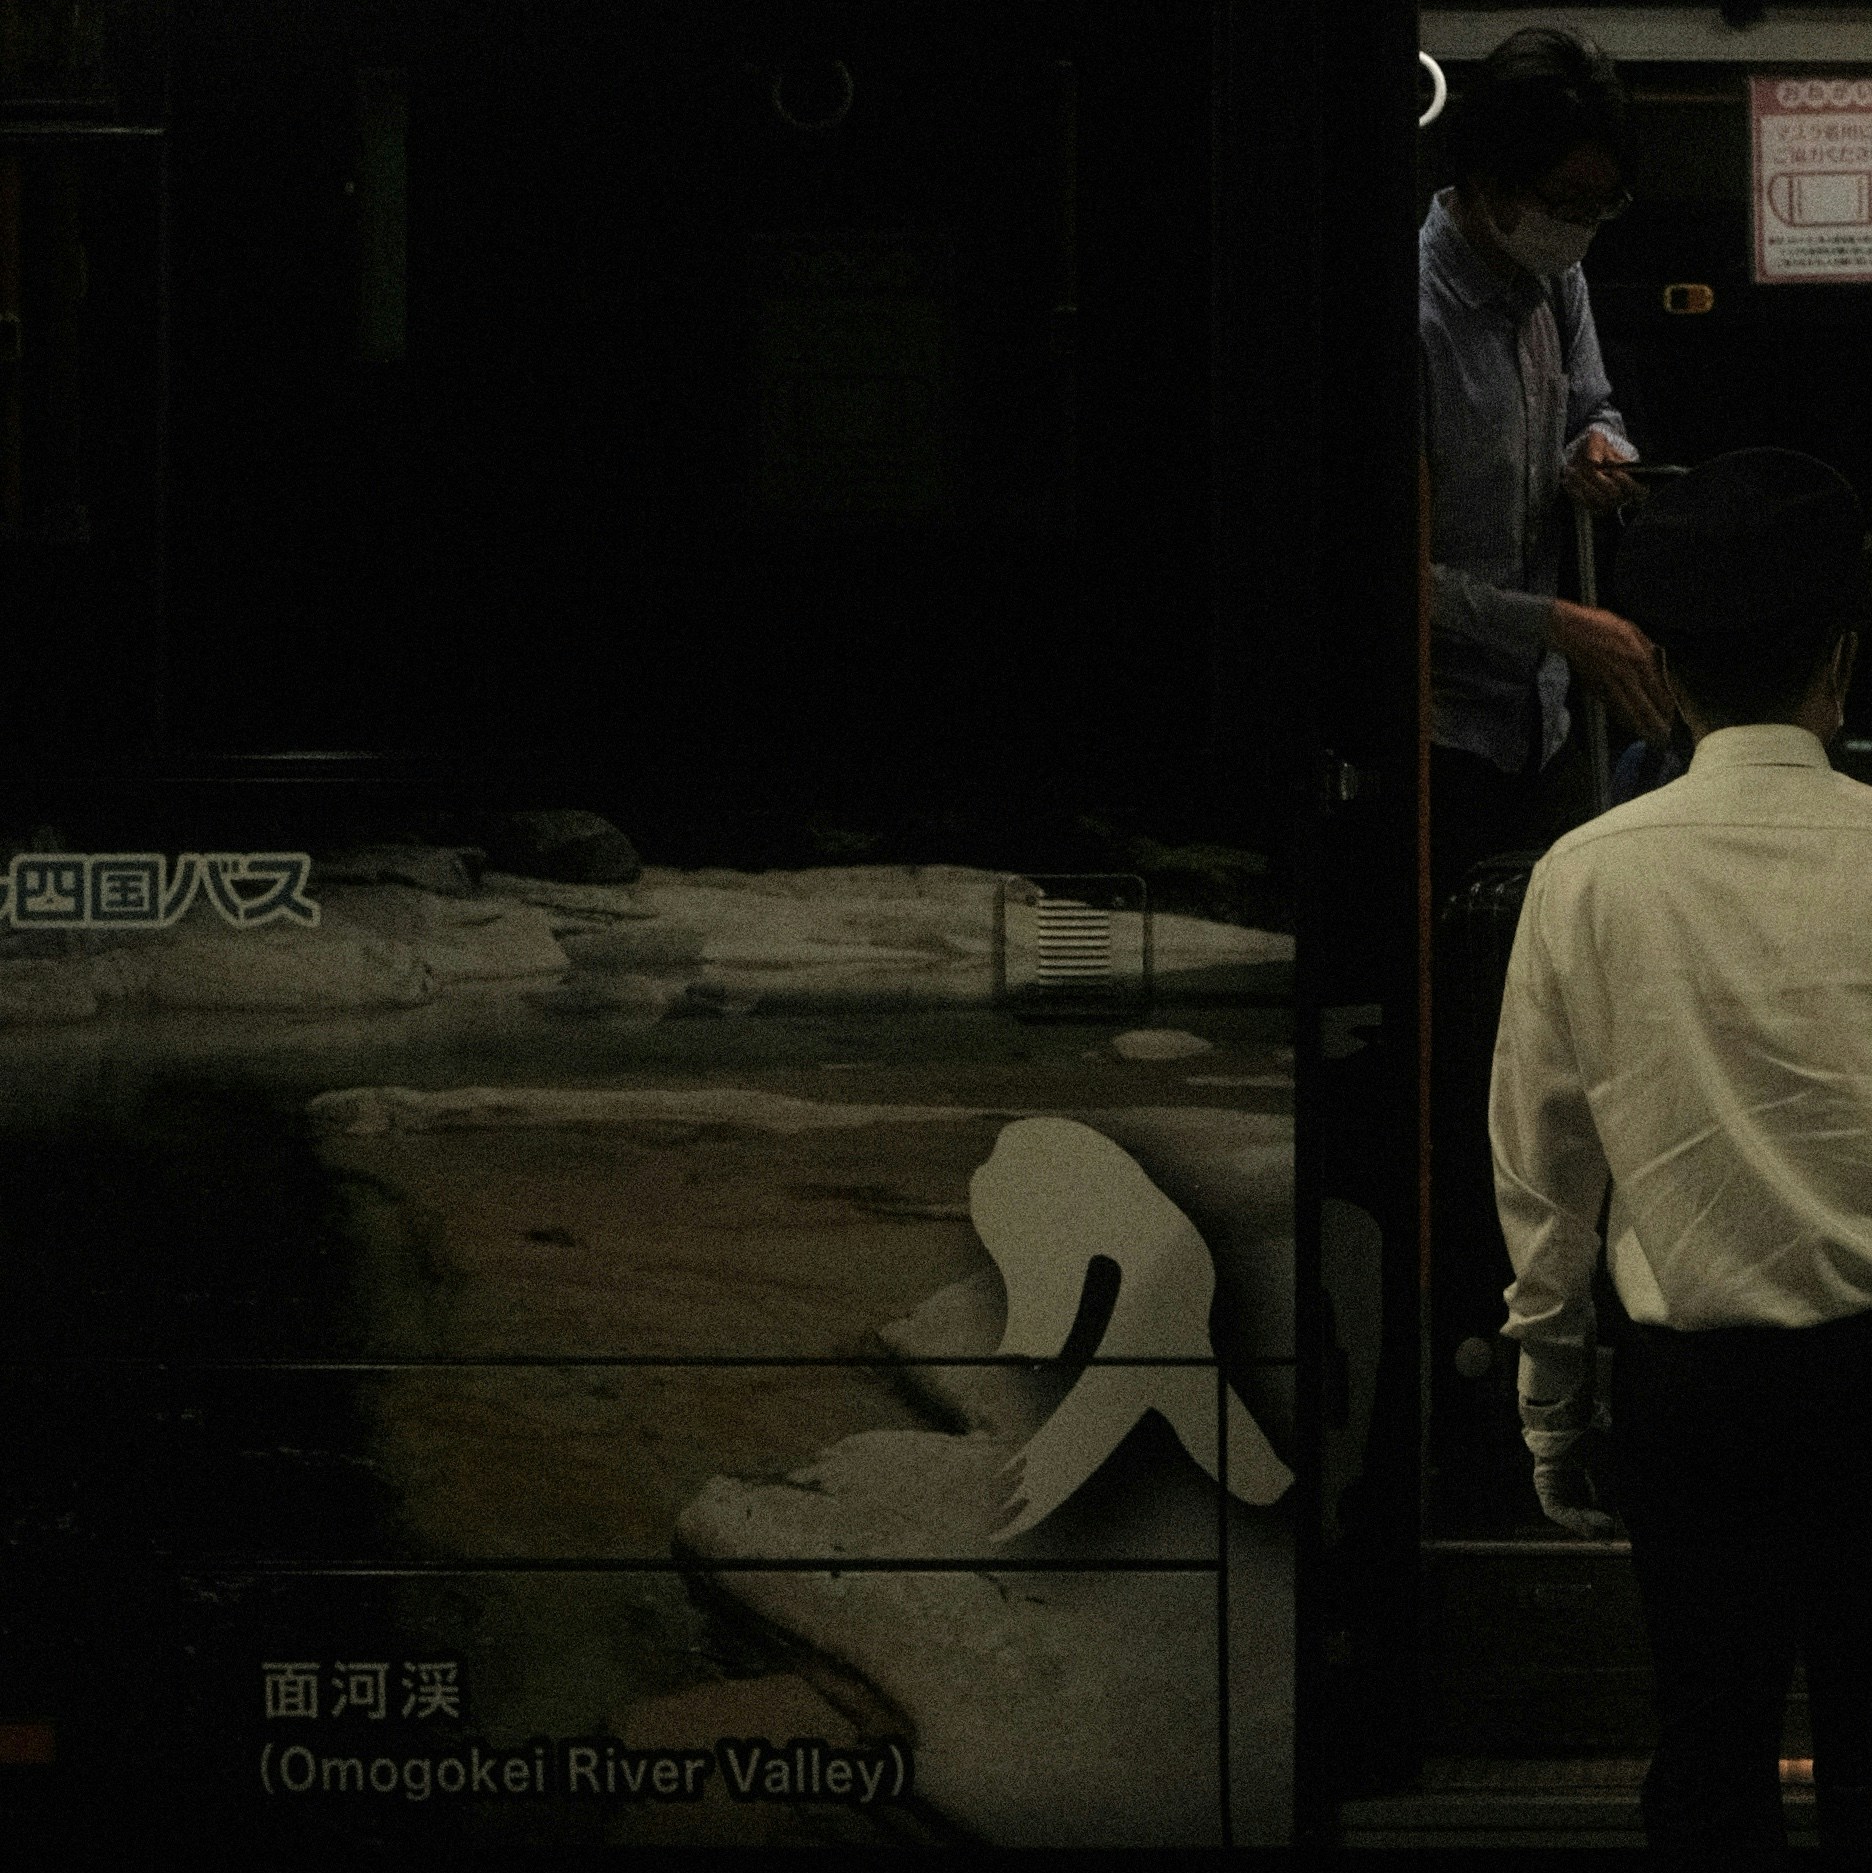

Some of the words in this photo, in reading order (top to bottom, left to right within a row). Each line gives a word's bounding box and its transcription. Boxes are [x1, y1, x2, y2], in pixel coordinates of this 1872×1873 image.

[0, 852, 320, 927] 四国バス
[262, 1660, 461, 1721] 面河渓
[259, 1743, 545, 1802] (Omogokei
[569, 1745, 706, 1795] River
[722, 1744, 907, 1805] Valley)
